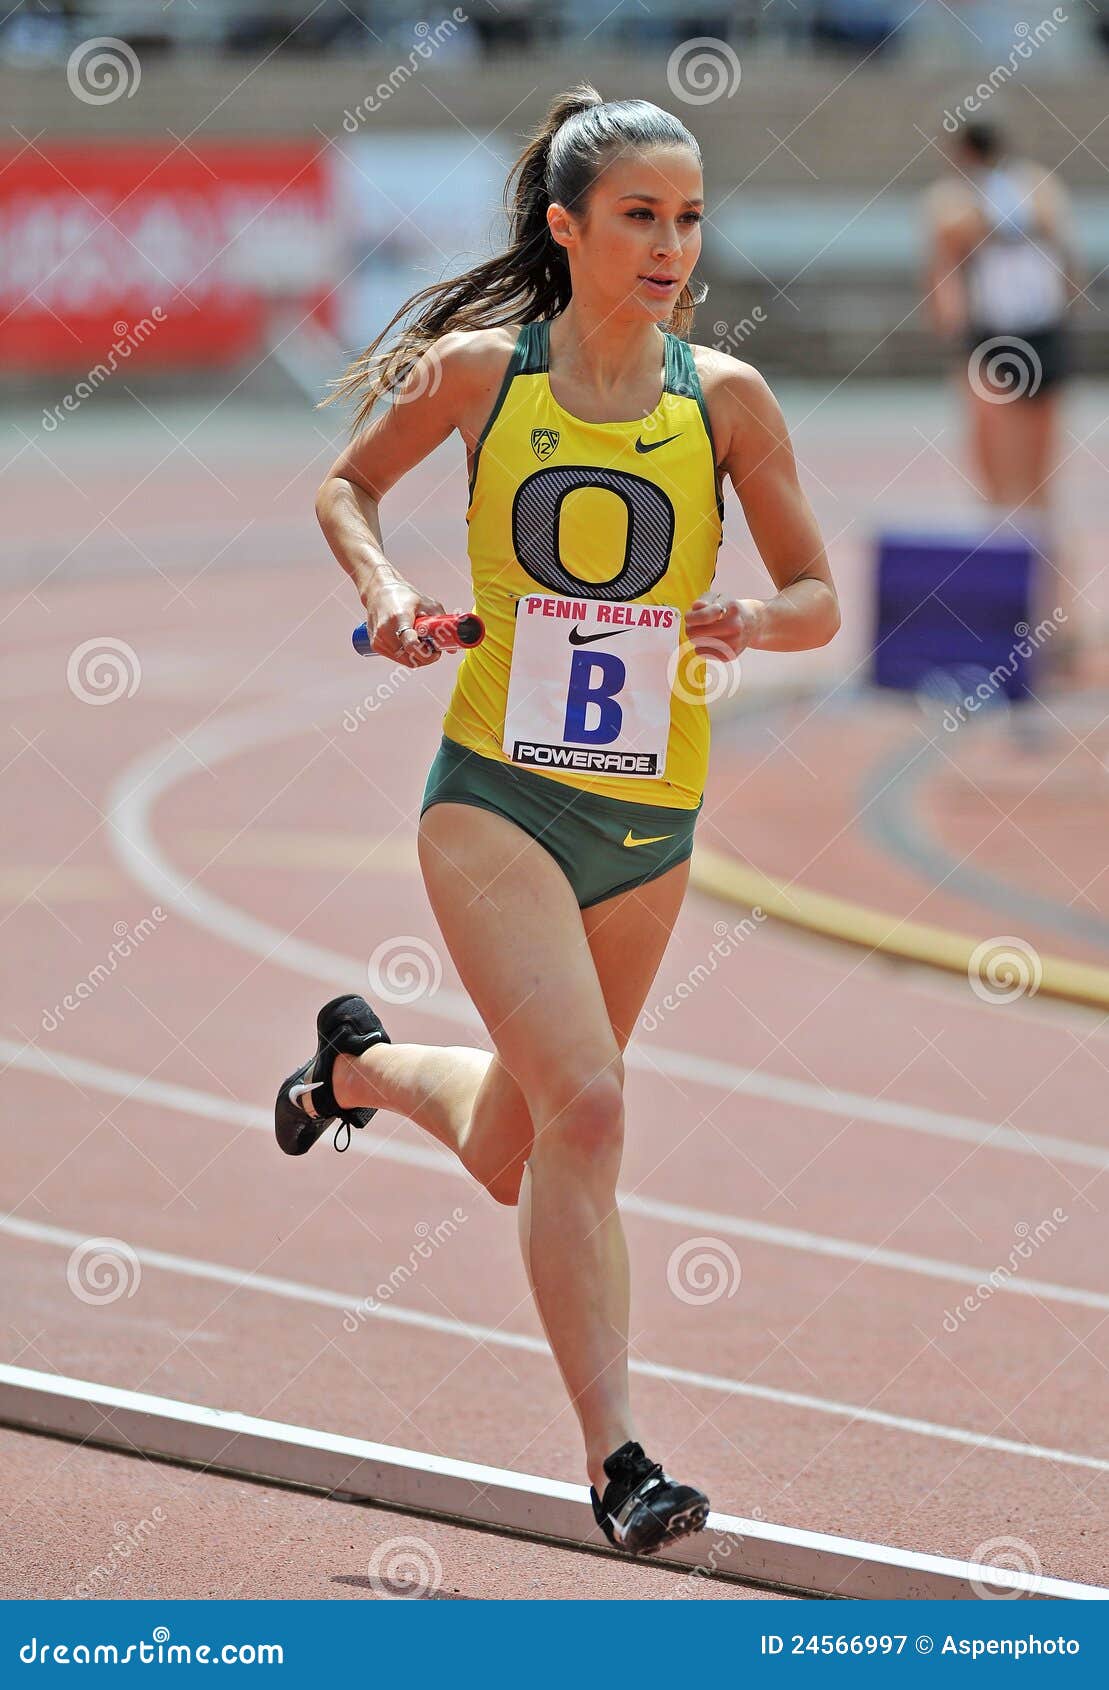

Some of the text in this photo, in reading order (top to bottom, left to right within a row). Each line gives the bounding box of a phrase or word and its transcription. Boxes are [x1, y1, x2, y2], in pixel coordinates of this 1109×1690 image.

[533, 430, 558, 449] PAC
[537, 442, 551, 454] 12
[527, 597, 674, 629] PENN RELAYS
[563, 649, 626, 745] B
